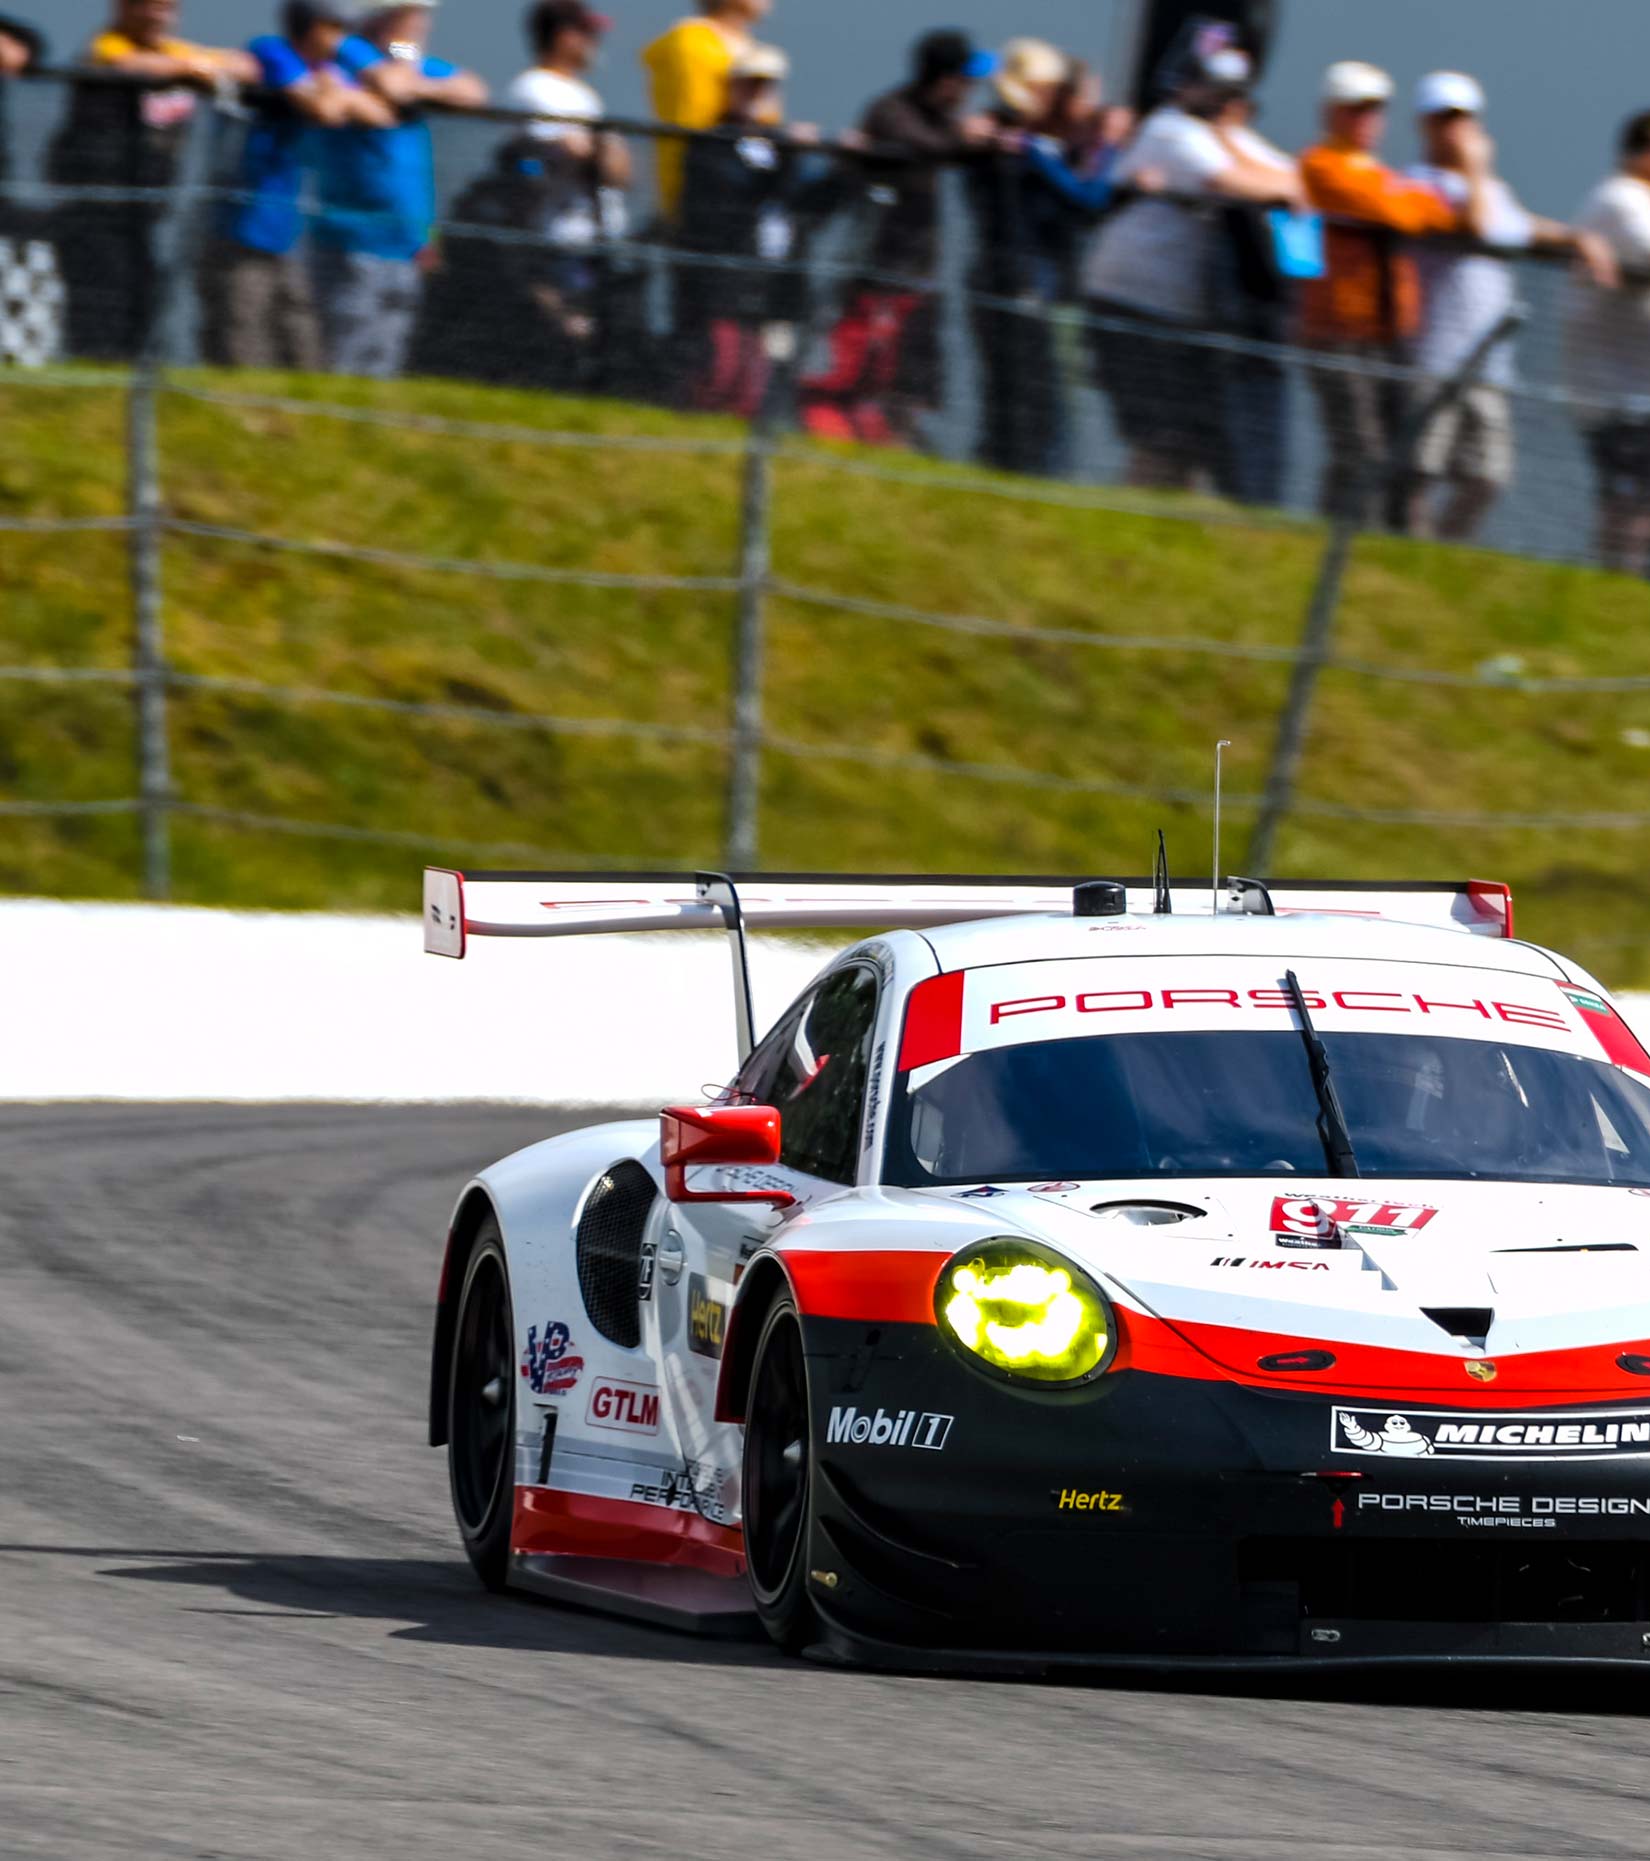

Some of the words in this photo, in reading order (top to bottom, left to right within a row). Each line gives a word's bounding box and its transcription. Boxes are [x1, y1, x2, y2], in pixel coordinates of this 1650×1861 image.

[989, 988, 1572, 1031] PORSCHE
[1281, 1198, 1425, 1236] 911
[691, 1289, 721, 1345] Hertz
[592, 1387, 659, 1427] GTLM
[826, 1406, 916, 1446] Mobil
[1435, 1423, 1650, 1445] MICHELIN
[1058, 1489, 1122, 1511] Hertz
[1358, 1494, 1520, 1513] PORSCHE
[1457, 1516, 1556, 1528] TIMEPIECES
